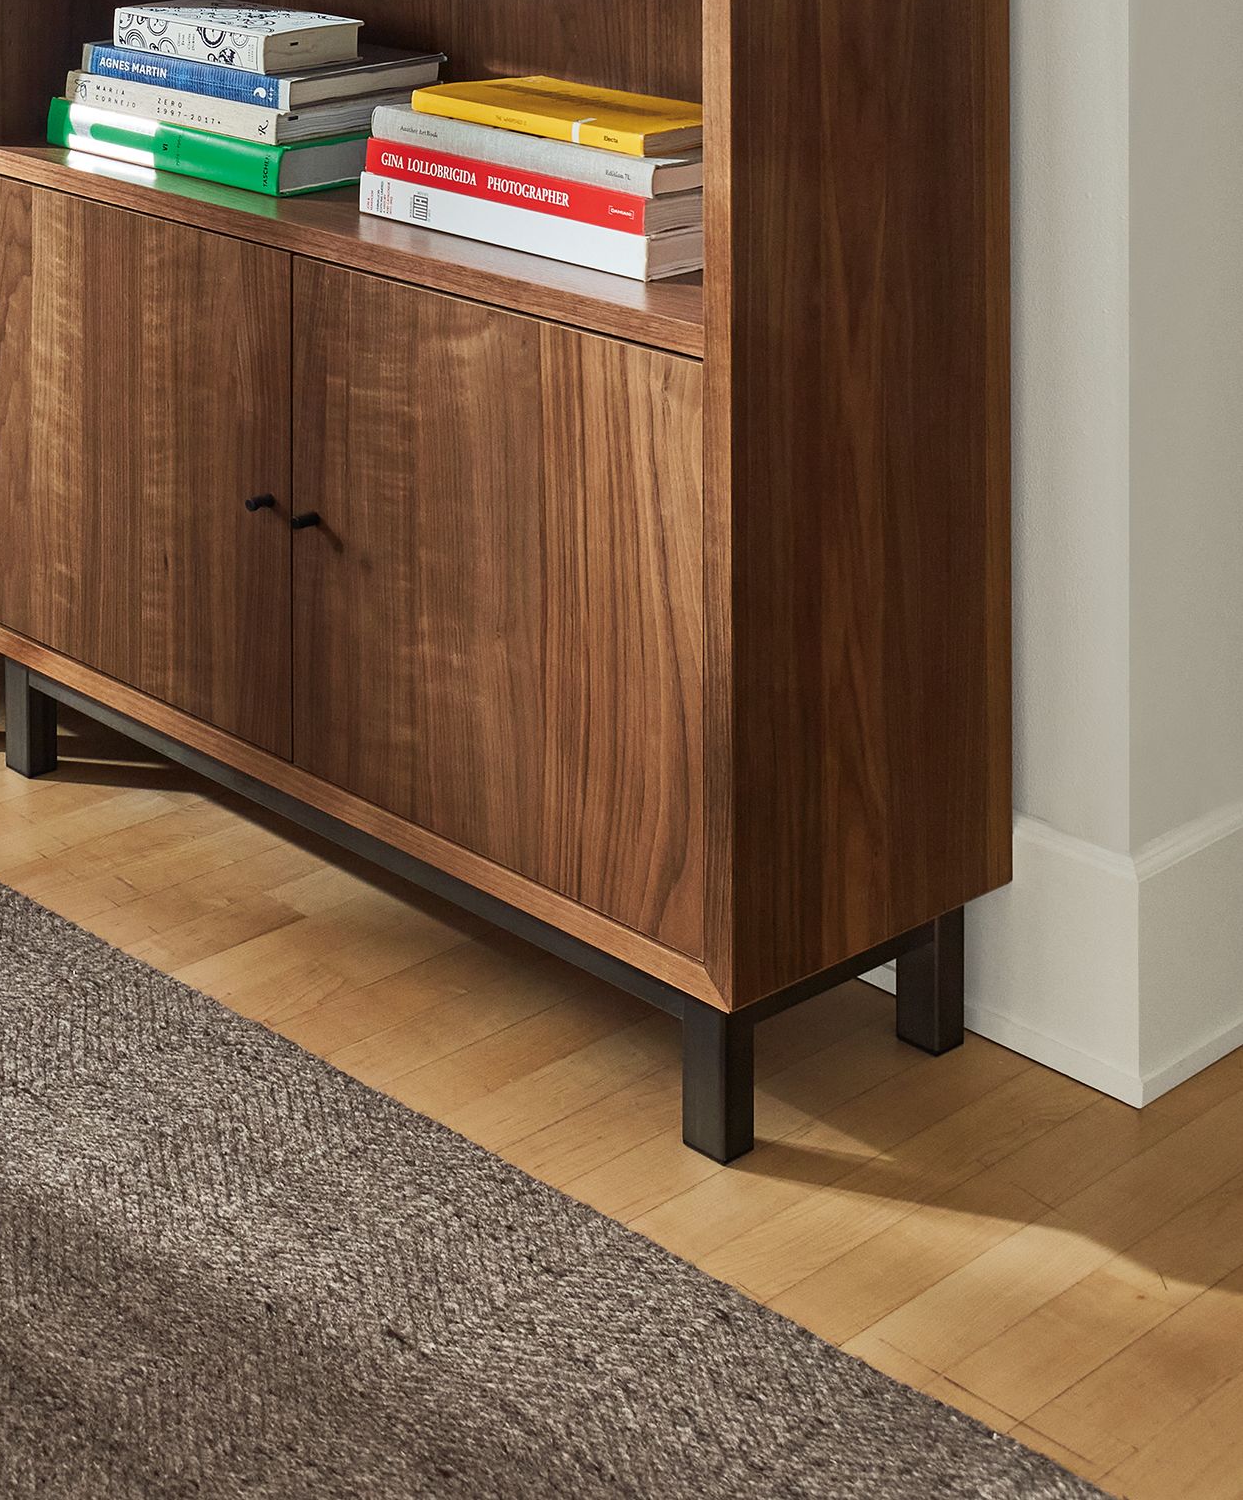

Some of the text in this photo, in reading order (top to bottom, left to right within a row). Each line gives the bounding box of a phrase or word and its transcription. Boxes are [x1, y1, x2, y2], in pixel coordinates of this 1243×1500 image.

[99, 56, 168, 79] AGNES MARTIN
[95, 85, 126, 96] MARIA
[95, 94, 137, 109] CORNEJO
[157, 97, 184, 109] ZERO
[603, 135, 619, 144] Electa
[380, 152, 570, 208] GINA LOLLOBRIGIDA PHOTOGRAPHER
